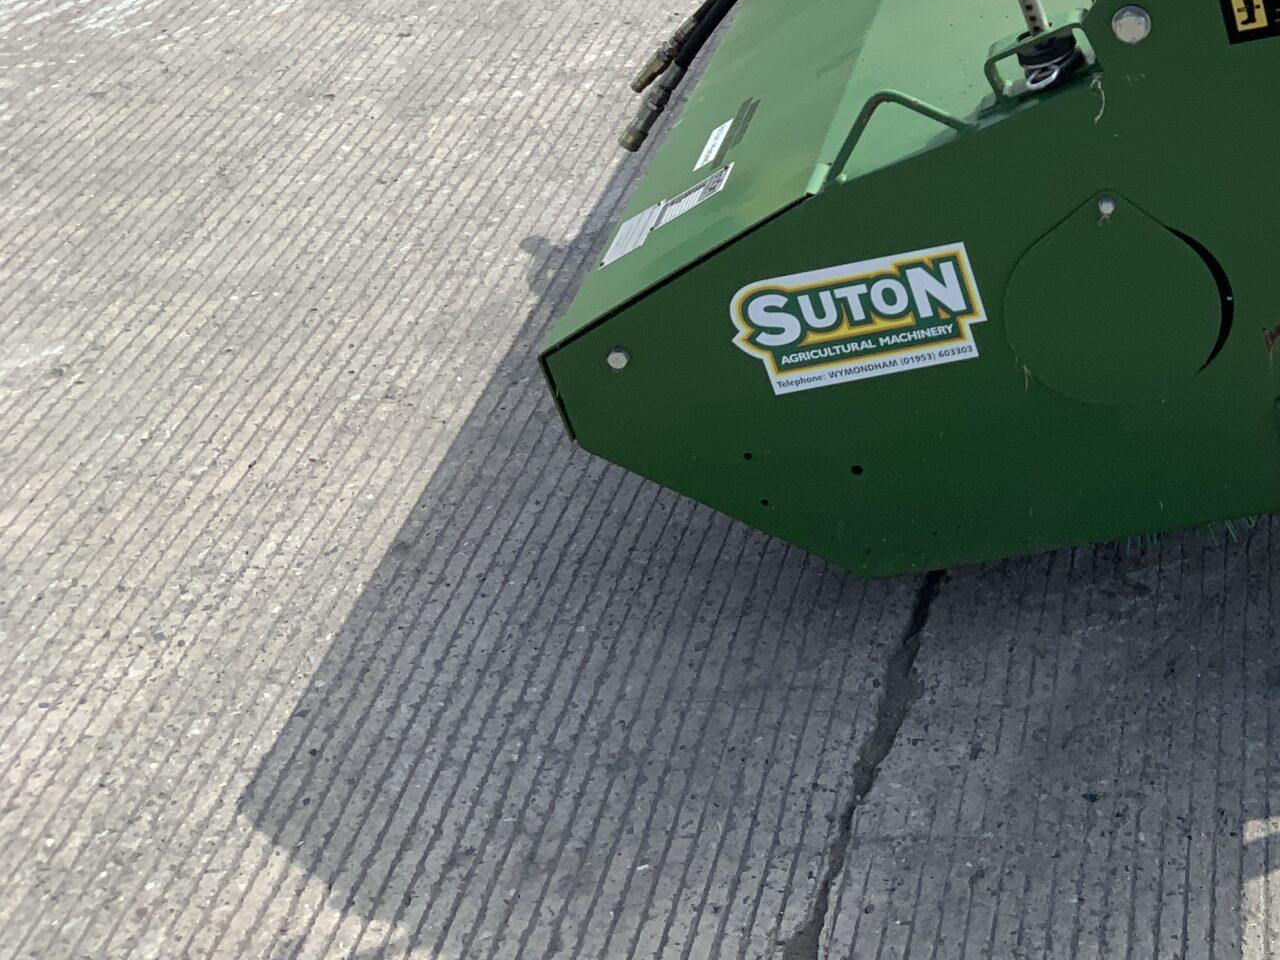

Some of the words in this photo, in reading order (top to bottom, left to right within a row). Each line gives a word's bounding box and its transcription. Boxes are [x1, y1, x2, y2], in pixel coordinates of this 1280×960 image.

[747, 259, 967, 347] SUTON
[776, 373, 827, 389] Telephone:
[828, 359, 899, 380] WYMONDHAM
[900, 351, 937, 368] (01953)
[938, 344, 974, 359] 603303
[781, 338, 876, 366] AGRICULTURAL
[879, 323, 954, 347] MACHINERY
